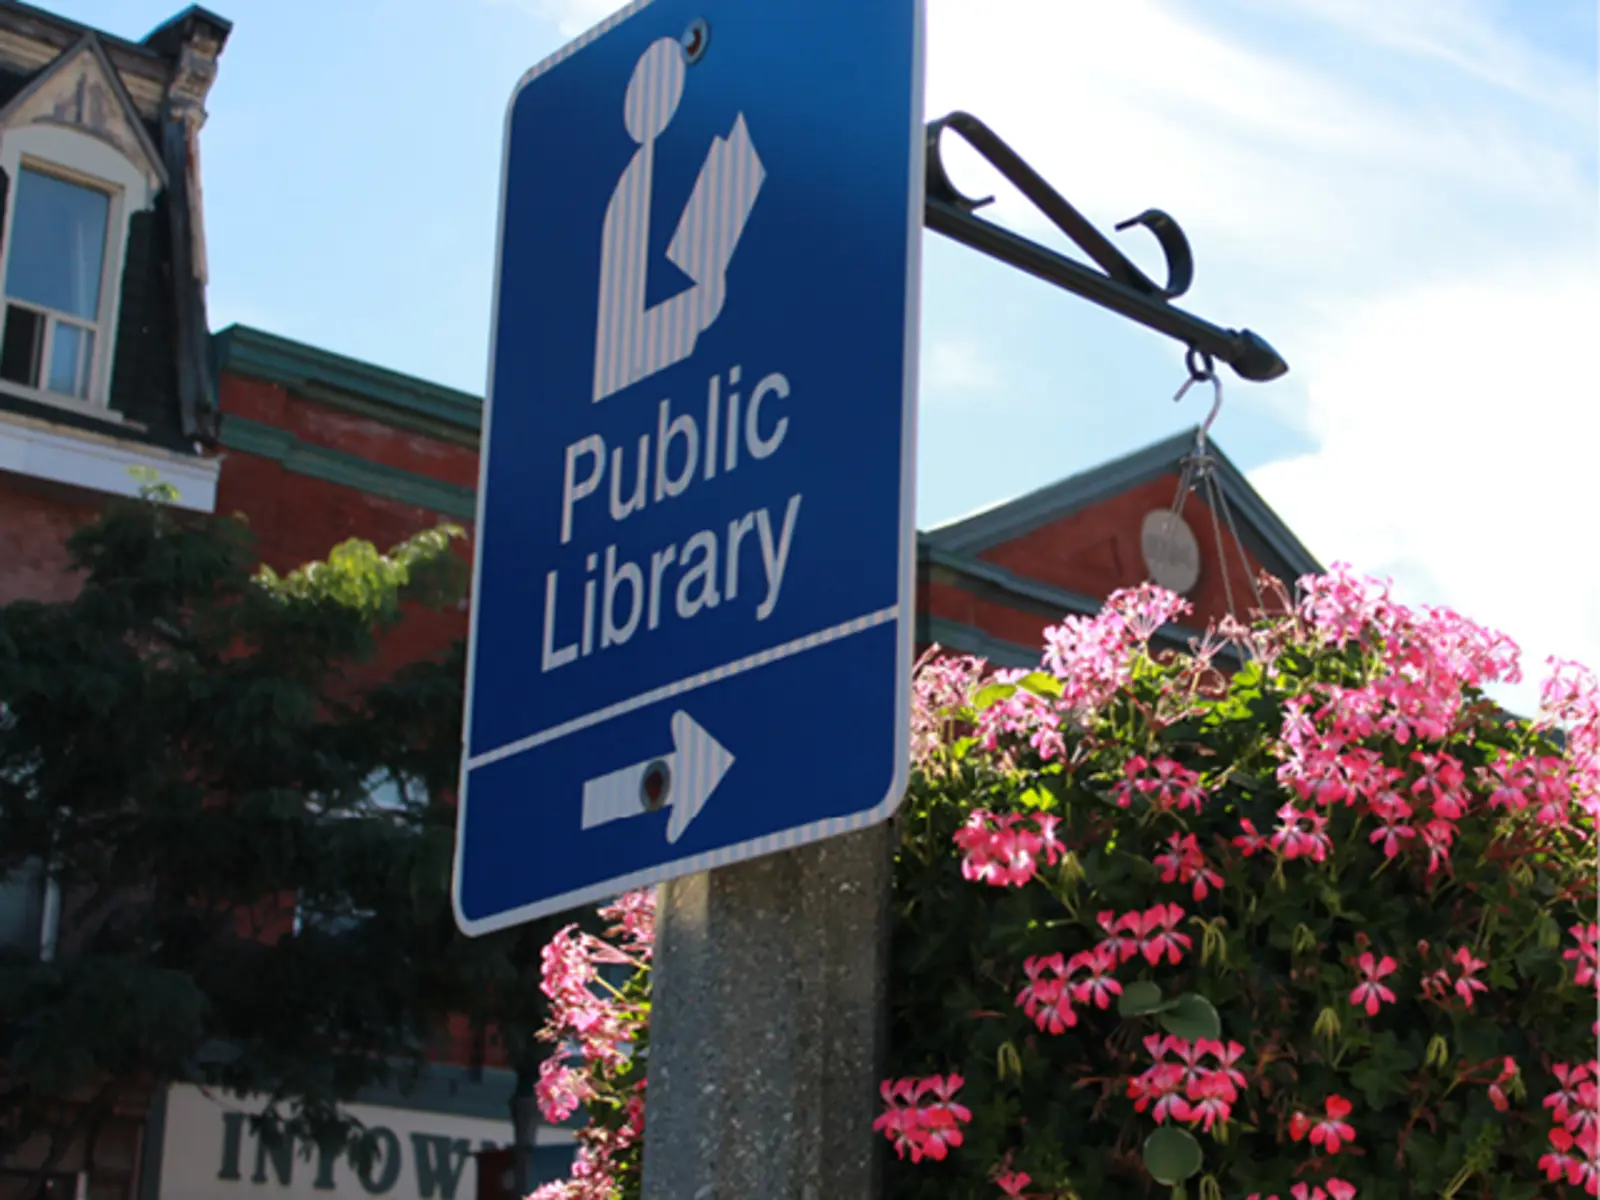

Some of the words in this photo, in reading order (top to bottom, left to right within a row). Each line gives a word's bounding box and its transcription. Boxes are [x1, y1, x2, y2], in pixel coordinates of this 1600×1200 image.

[560, 364, 791, 545] Public
[541, 493, 802, 673] Library
[217, 1112, 513, 1200] INTOW
